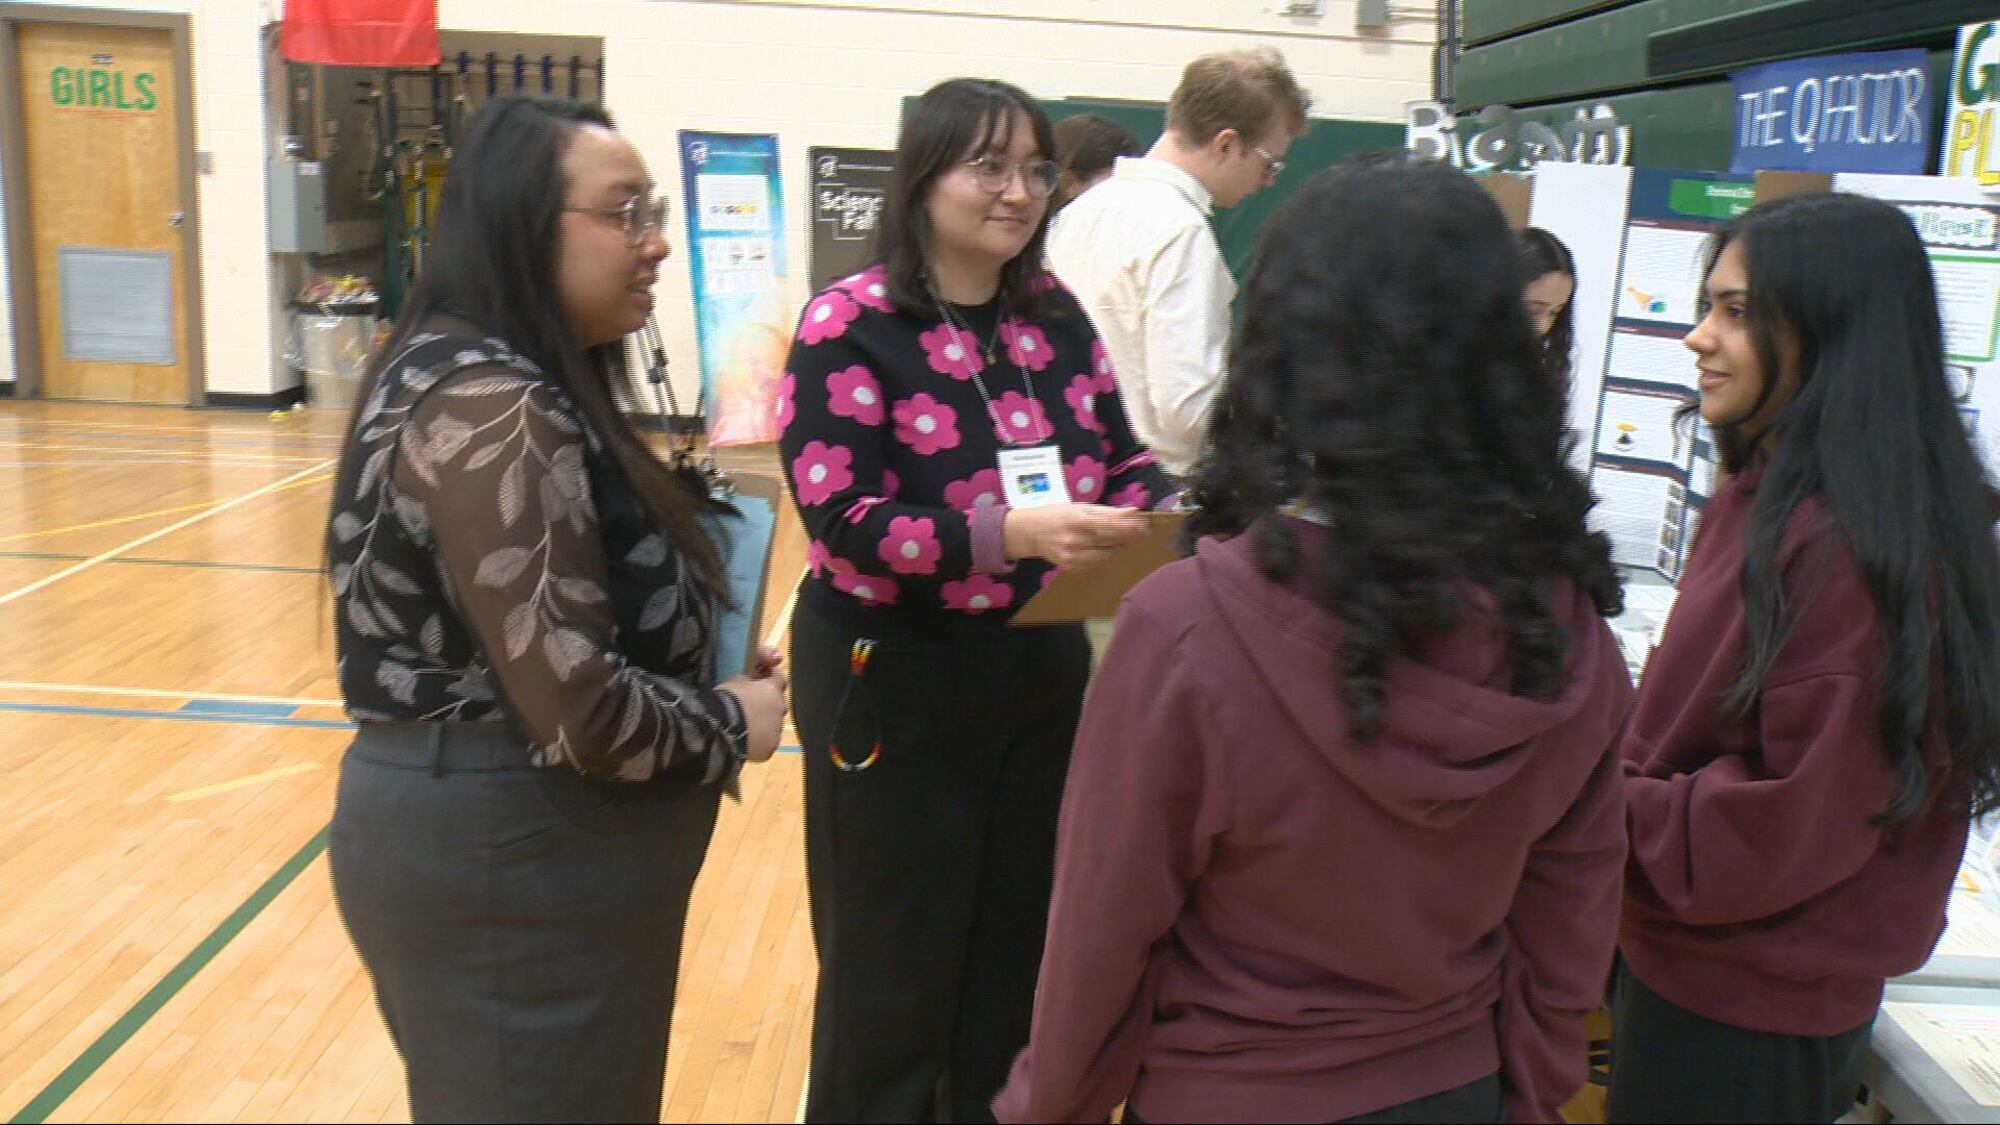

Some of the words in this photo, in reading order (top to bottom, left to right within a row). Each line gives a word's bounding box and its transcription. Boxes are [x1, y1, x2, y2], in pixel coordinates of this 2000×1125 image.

[50, 66, 158, 111] GIRLS
[1738, 85, 1790, 148] THE
[1791, 77, 1822, 153] Q
[1818, 67, 1926, 144] FACTOR
[818, 190, 886, 212] Scienc
